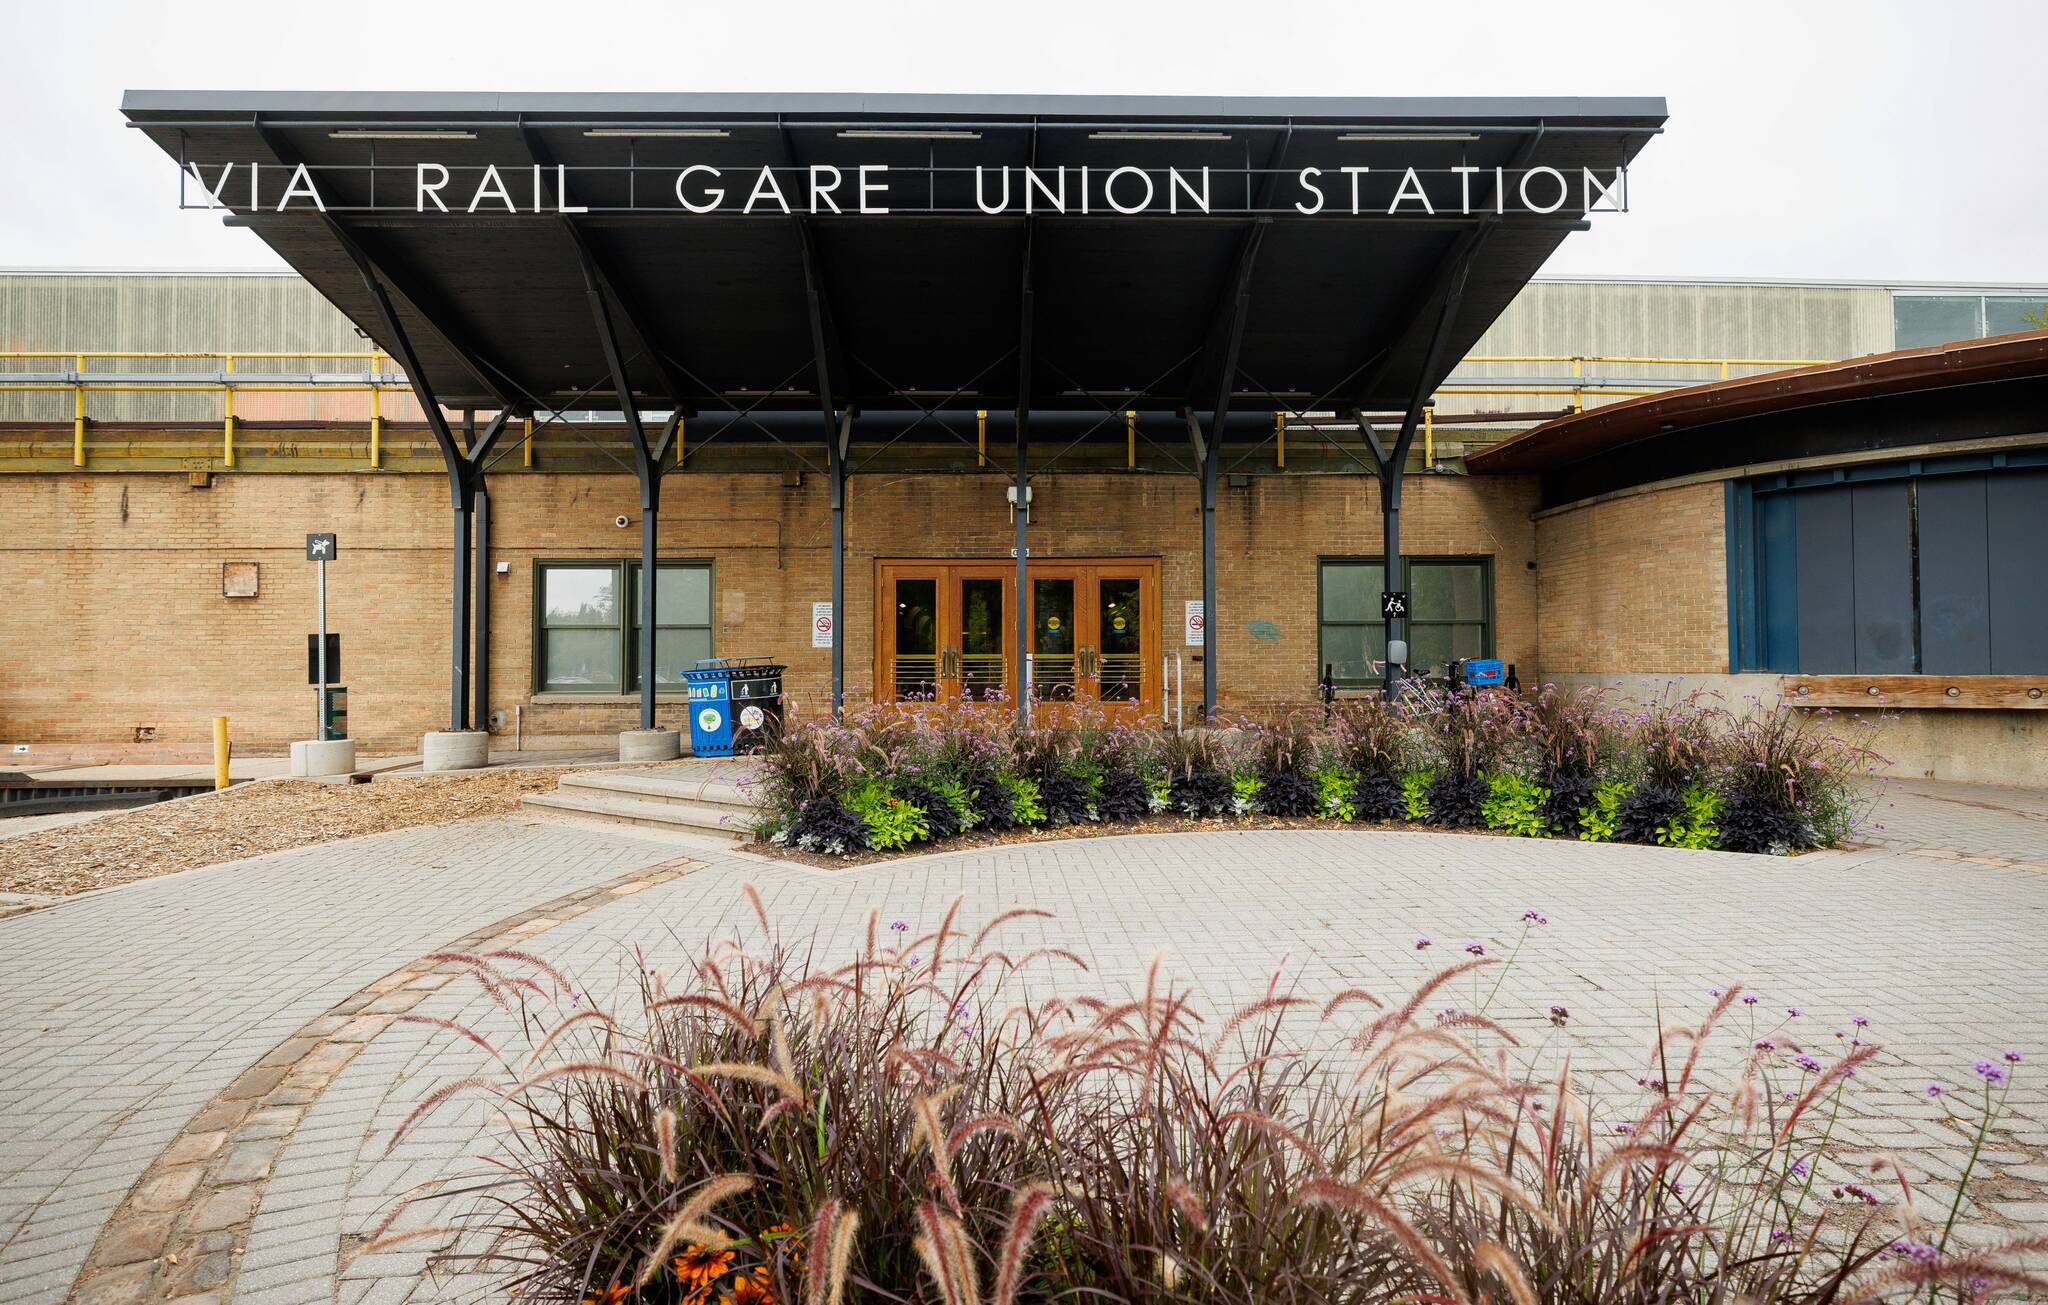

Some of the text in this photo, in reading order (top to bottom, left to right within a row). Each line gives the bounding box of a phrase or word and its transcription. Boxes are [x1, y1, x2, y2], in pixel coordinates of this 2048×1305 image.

[189, 161, 1622, 215] VIA RAIL GARE UNION STATION
